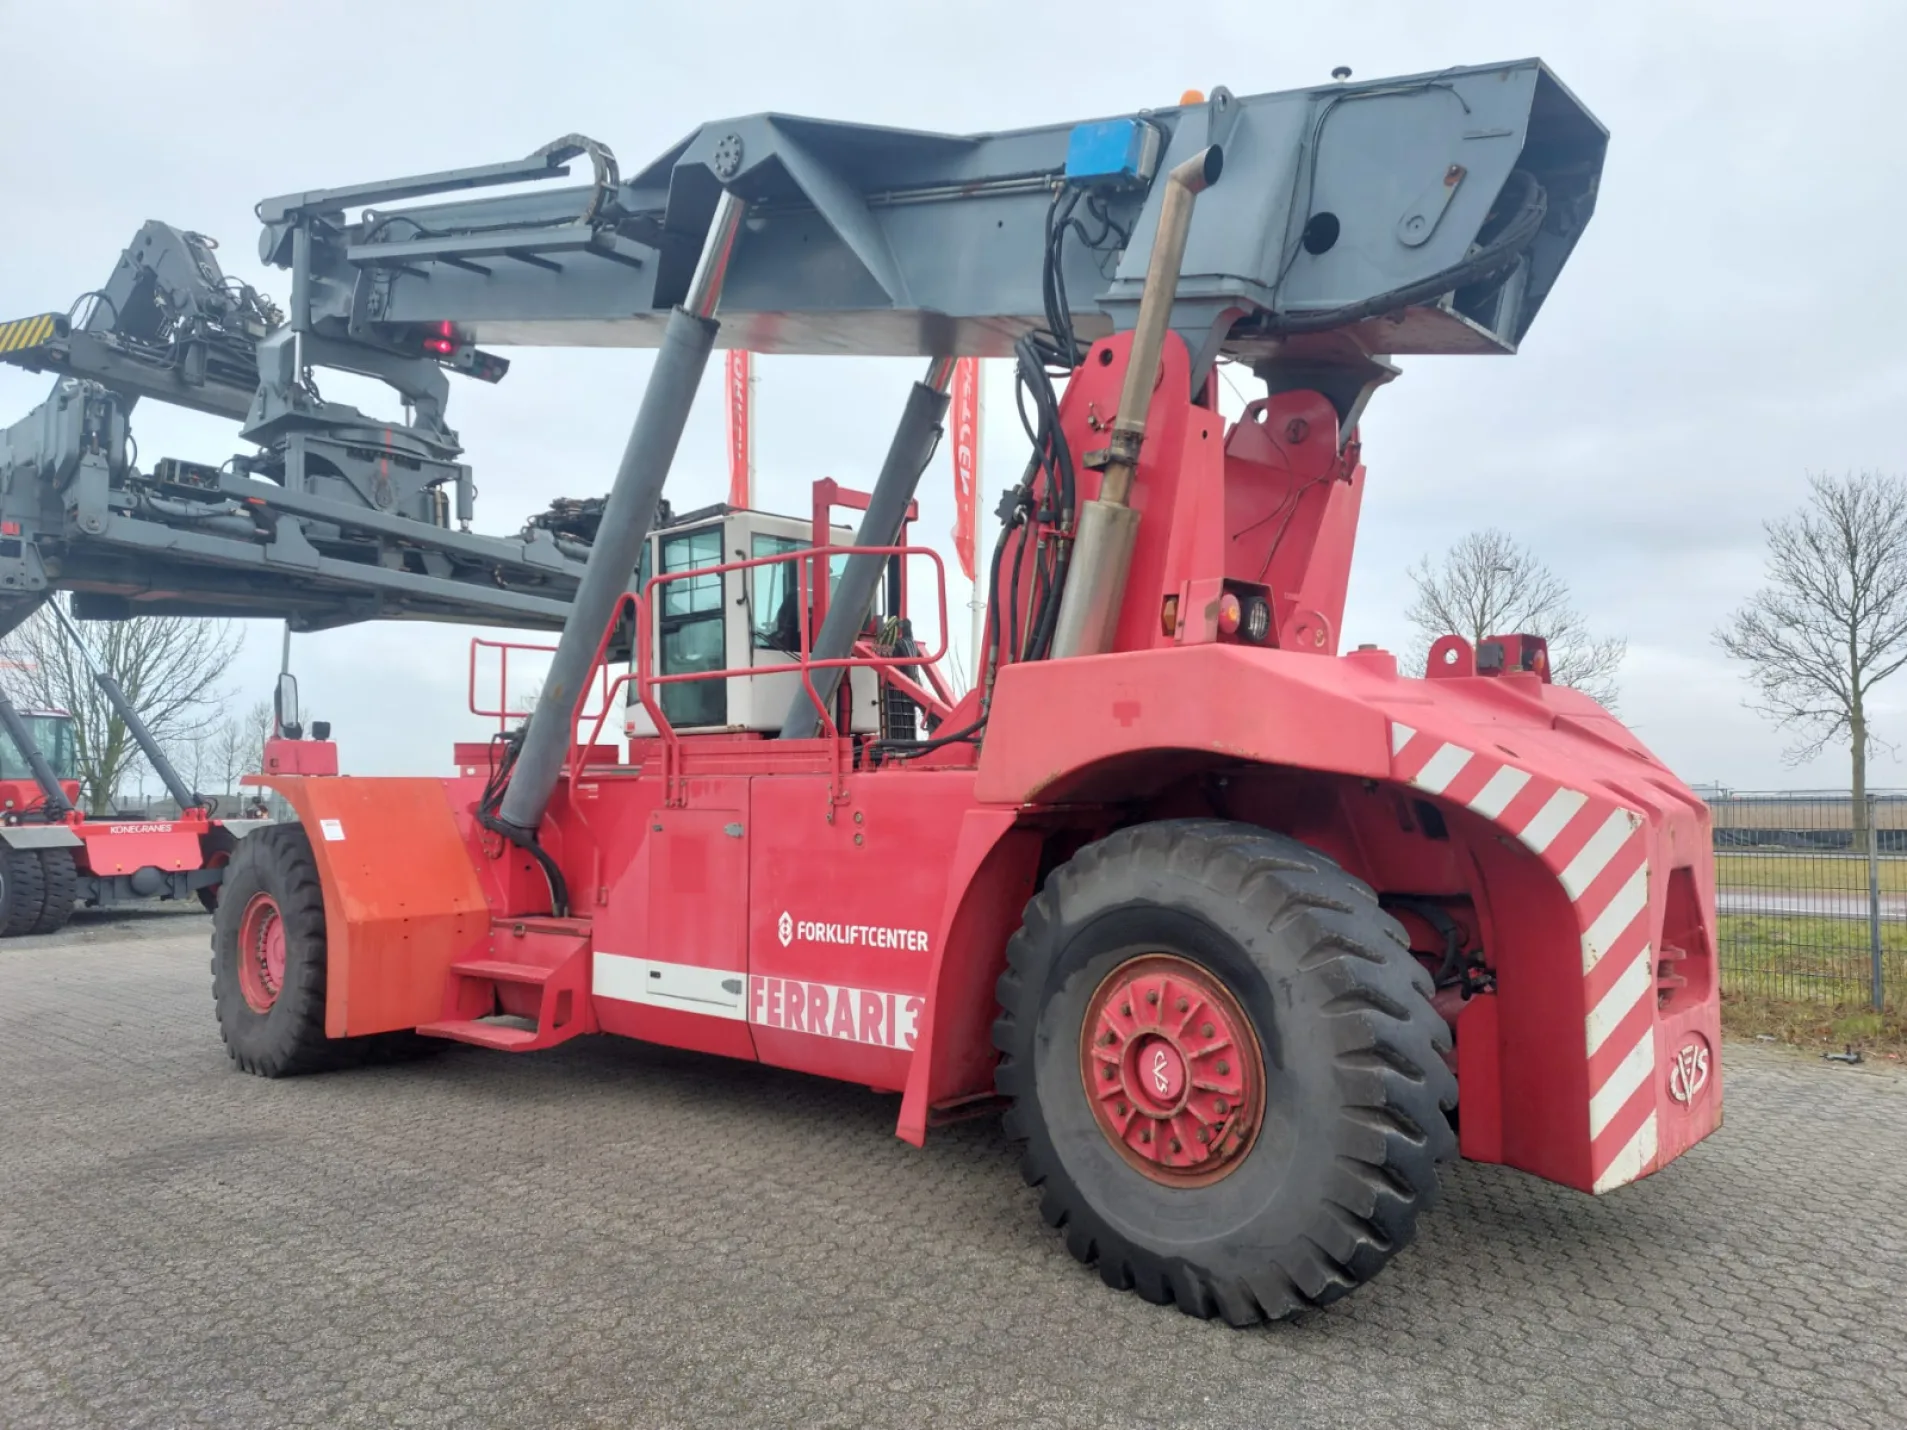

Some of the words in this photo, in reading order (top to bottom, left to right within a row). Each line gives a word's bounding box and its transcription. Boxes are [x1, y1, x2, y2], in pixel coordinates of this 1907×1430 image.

[110, 824, 172, 834] KONECRANES
[797, 921, 929, 952] FORKLIFTCENTER
[750, 976, 897, 1047] FERRARI
